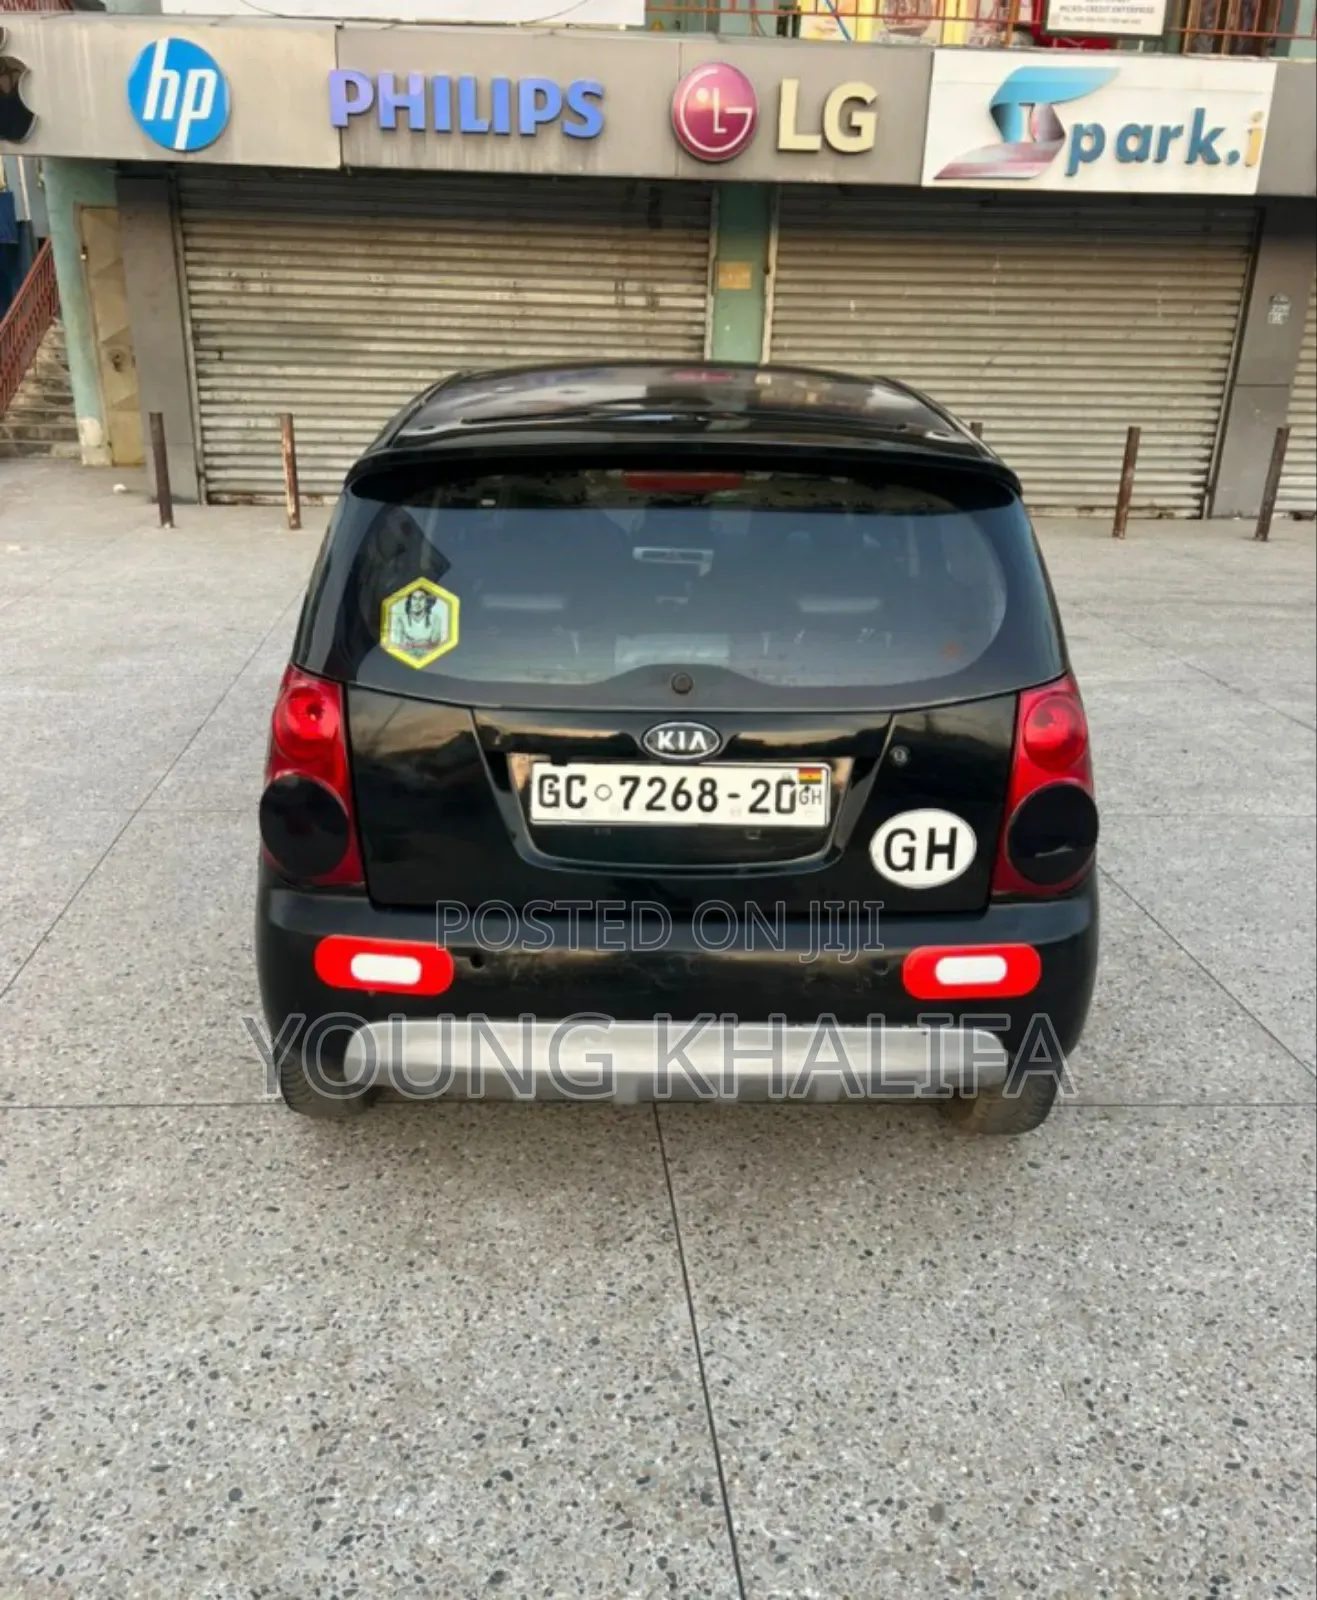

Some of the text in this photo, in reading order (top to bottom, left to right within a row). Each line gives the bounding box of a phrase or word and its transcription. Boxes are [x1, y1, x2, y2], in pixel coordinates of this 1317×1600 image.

[142, 36, 217, 151] hp
[328, 68, 605, 140] PHILIPS
[776, 78, 878, 154] LG
[656, 729, 709, 753] KIA
[538, 774, 588, 809] GC
[799, 787, 822, 805] GH
[884, 827, 958, 872] GH
